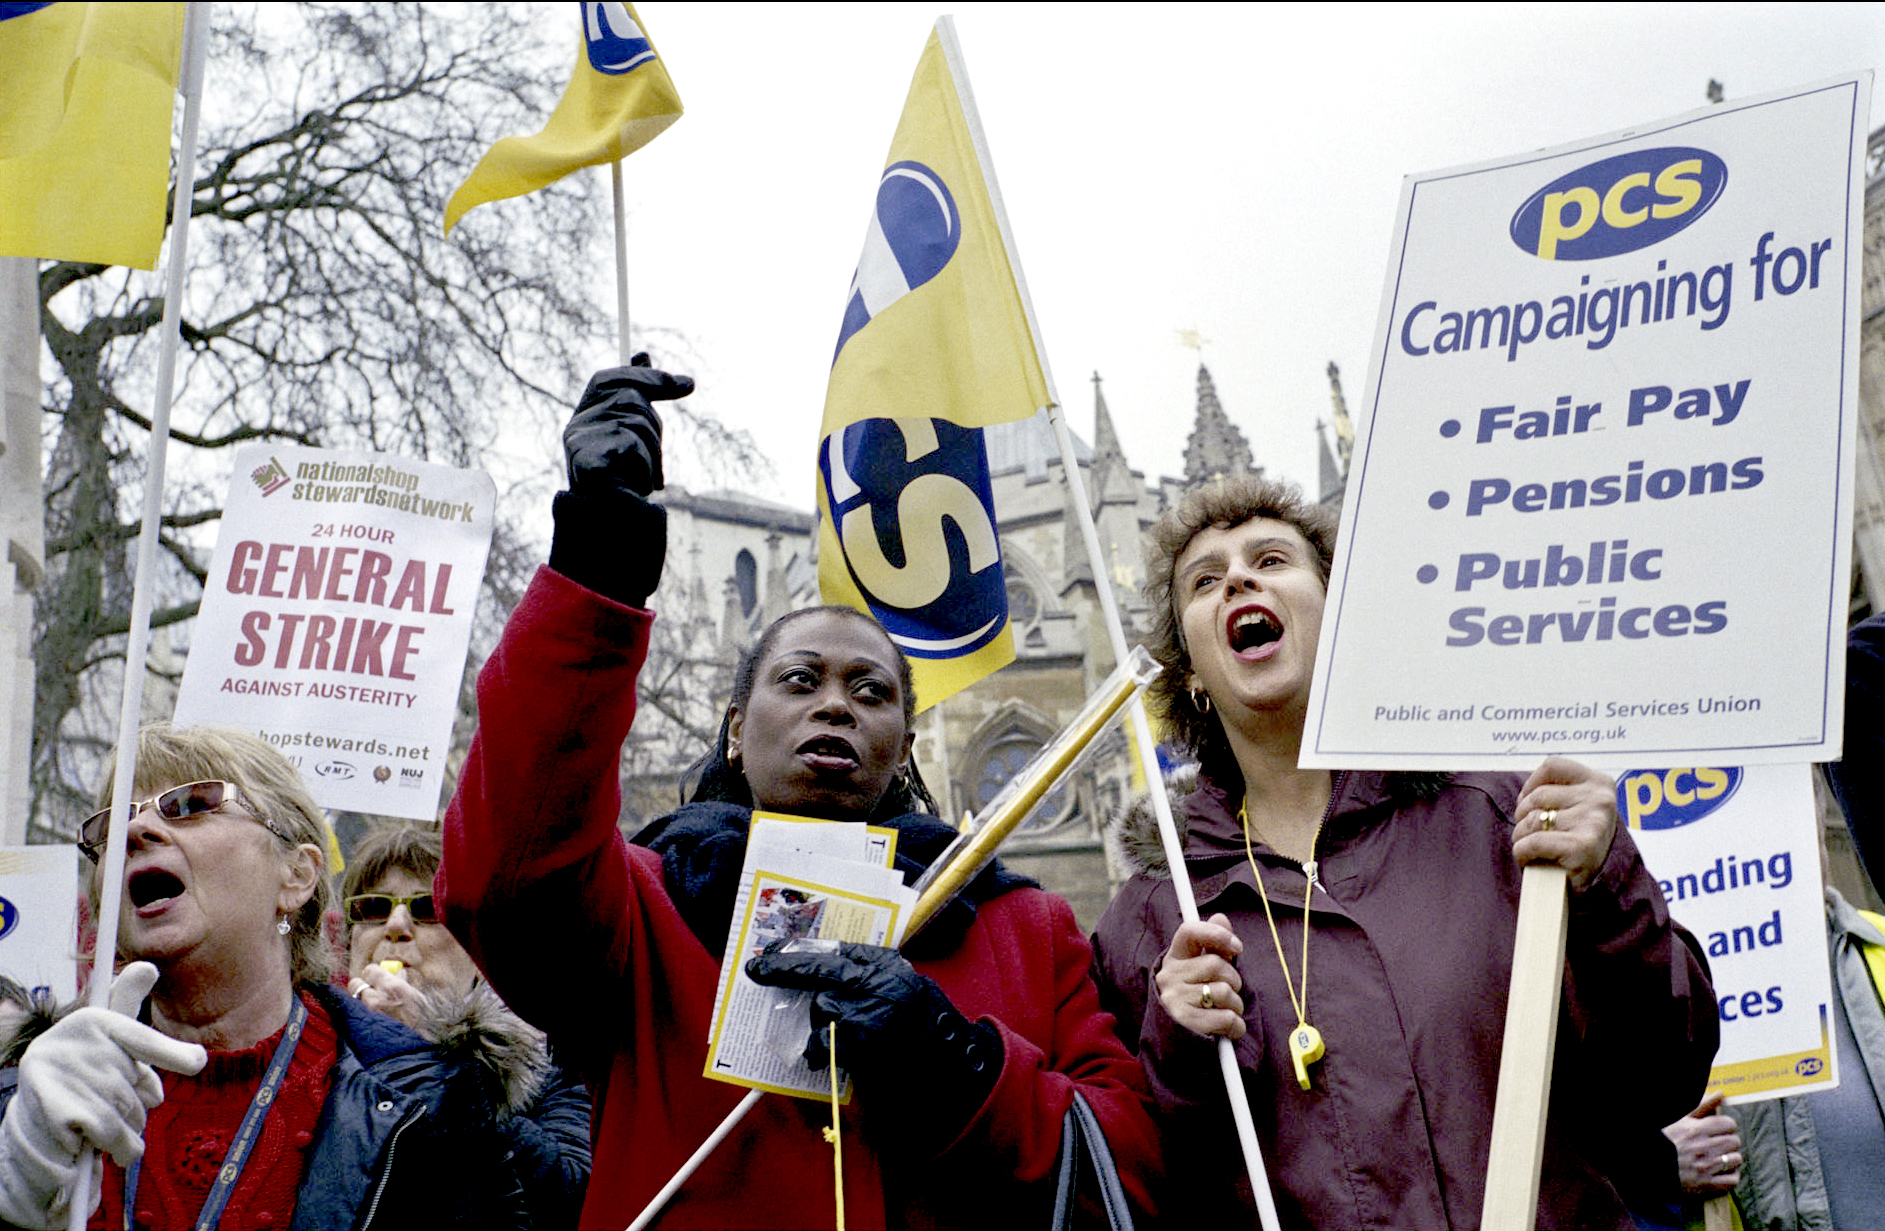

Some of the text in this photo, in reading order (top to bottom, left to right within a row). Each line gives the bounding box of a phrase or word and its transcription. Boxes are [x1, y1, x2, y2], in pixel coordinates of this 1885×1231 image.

[1538, 158, 1704, 261] pcs
[1400, 231, 1832, 362] Campaigning for
[1476, 379, 1752, 444] Fair Pay
[292, 480, 475, 523] stewardsnetwork
[296, 461, 420, 493] nationalshop
[1466, 456, 1764, 517] Pensions
[311, 523, 395, 545] 24 HOUR
[226, 540, 455, 616] GENERAL
[1455, 540, 1663, 592] Public
[234, 610, 425, 682] STRIKE
[1445, 597, 1728, 647] Services
[221, 677, 417, 709] AGAINST AUSTERITY
[1374, 697, 1761, 722] Public and Commercial Services Union
[259, 730, 431, 761] hopstewards.net
[1492, 727, 1626, 744] www.pcs.org.uk
[1625, 767, 1728, 831] pcs
[1658, 851, 1794, 904] ending
[1708, 910, 1783, 957] and
[1719, 986, 1784, 1023] ces
